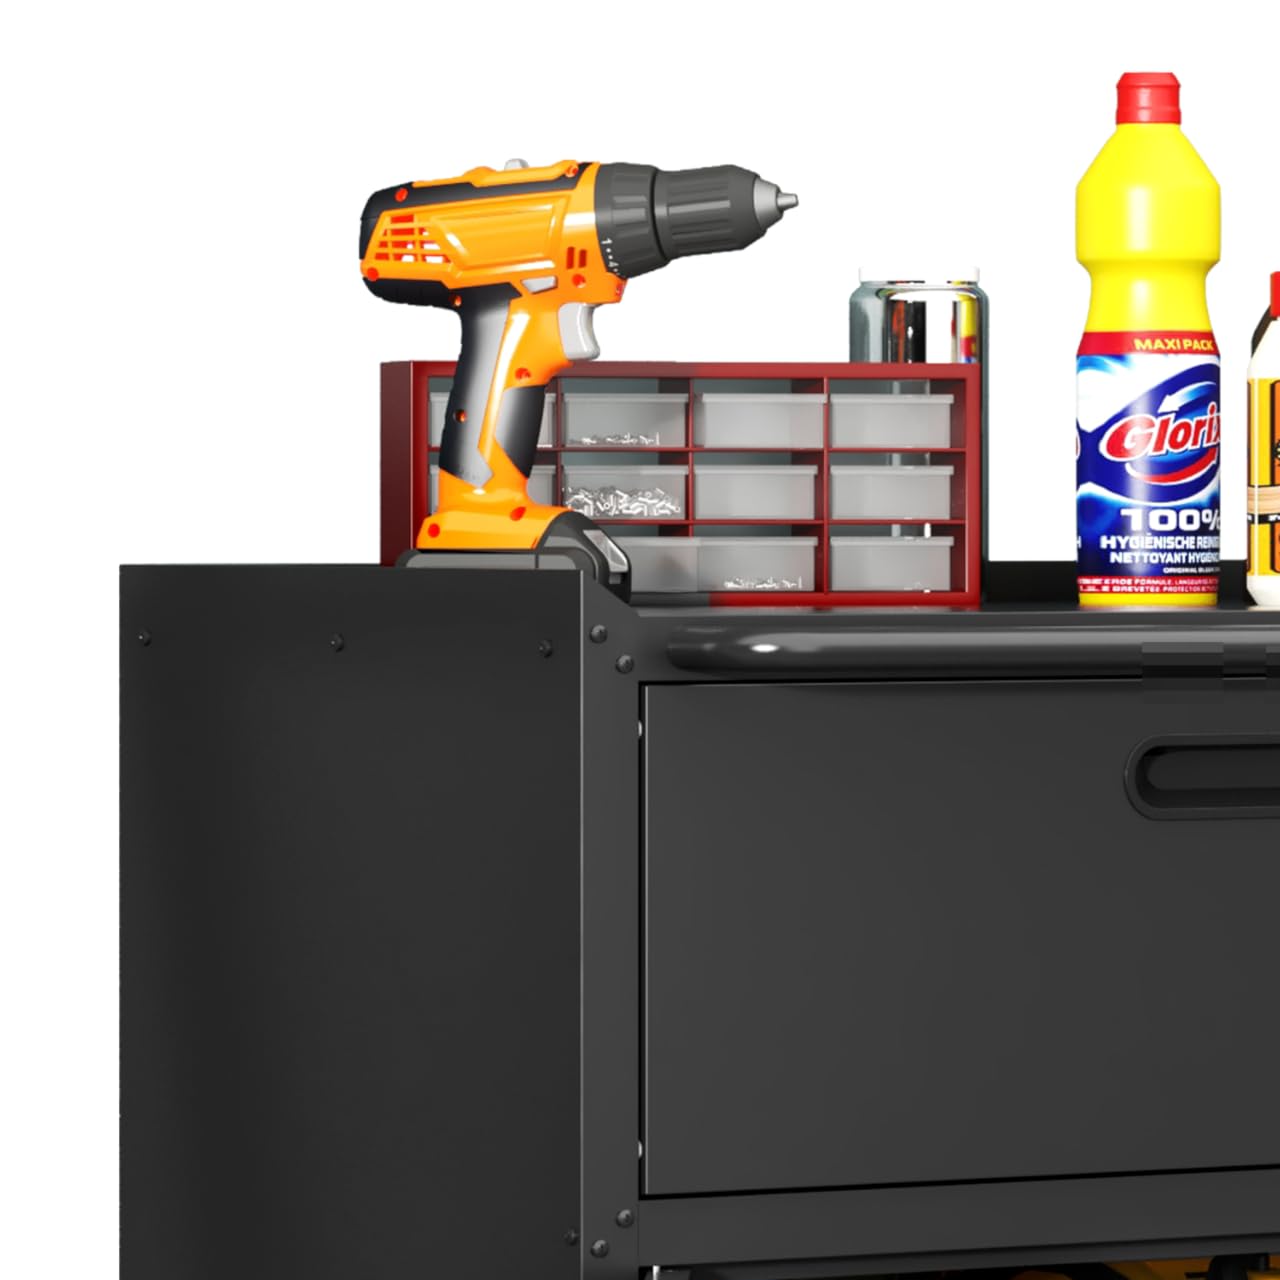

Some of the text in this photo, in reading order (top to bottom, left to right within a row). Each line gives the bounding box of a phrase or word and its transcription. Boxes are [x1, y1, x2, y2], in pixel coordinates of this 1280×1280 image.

[1134, 339, 1214, 351] MAXI PACK
[1120, 508, 1220, 531] 100%
[1110, 552, 1187, 563] NETTOYANT
